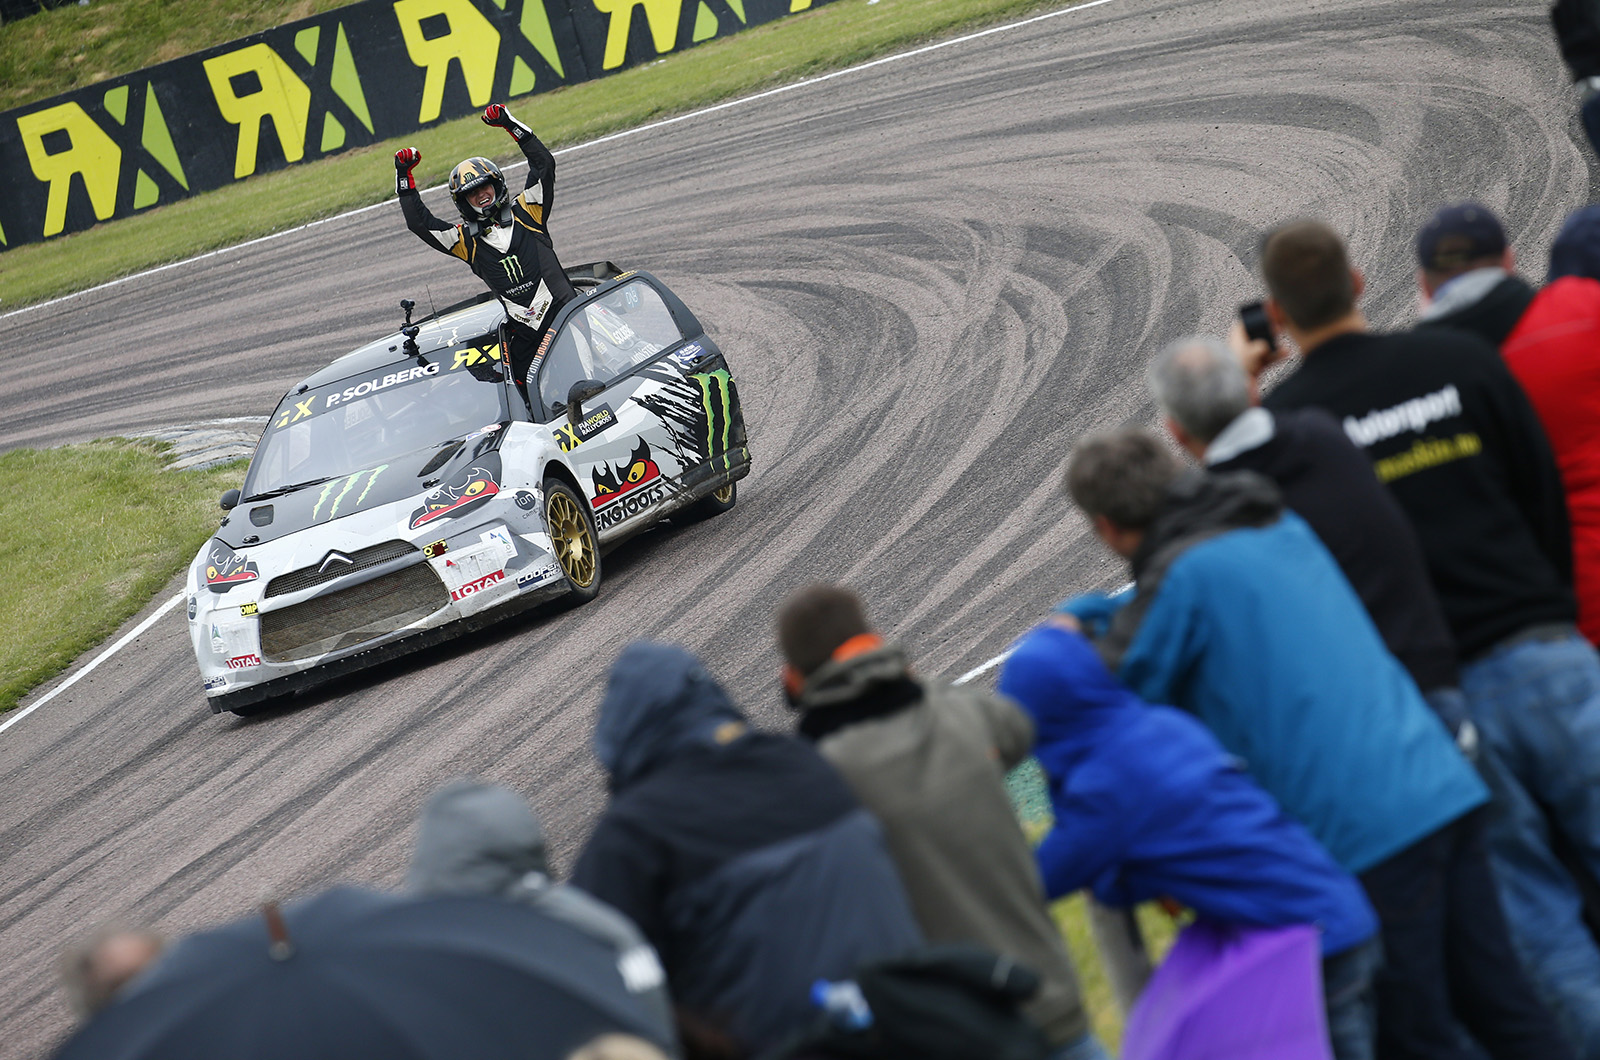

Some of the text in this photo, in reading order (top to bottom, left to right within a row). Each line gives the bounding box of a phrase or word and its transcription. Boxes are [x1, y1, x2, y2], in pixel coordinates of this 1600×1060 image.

[516, 492, 534, 506] ion
[450, 573, 506, 600] TOTAL
[241, 604, 258, 614] OMP
[226, 655, 261, 669] TOTAL
